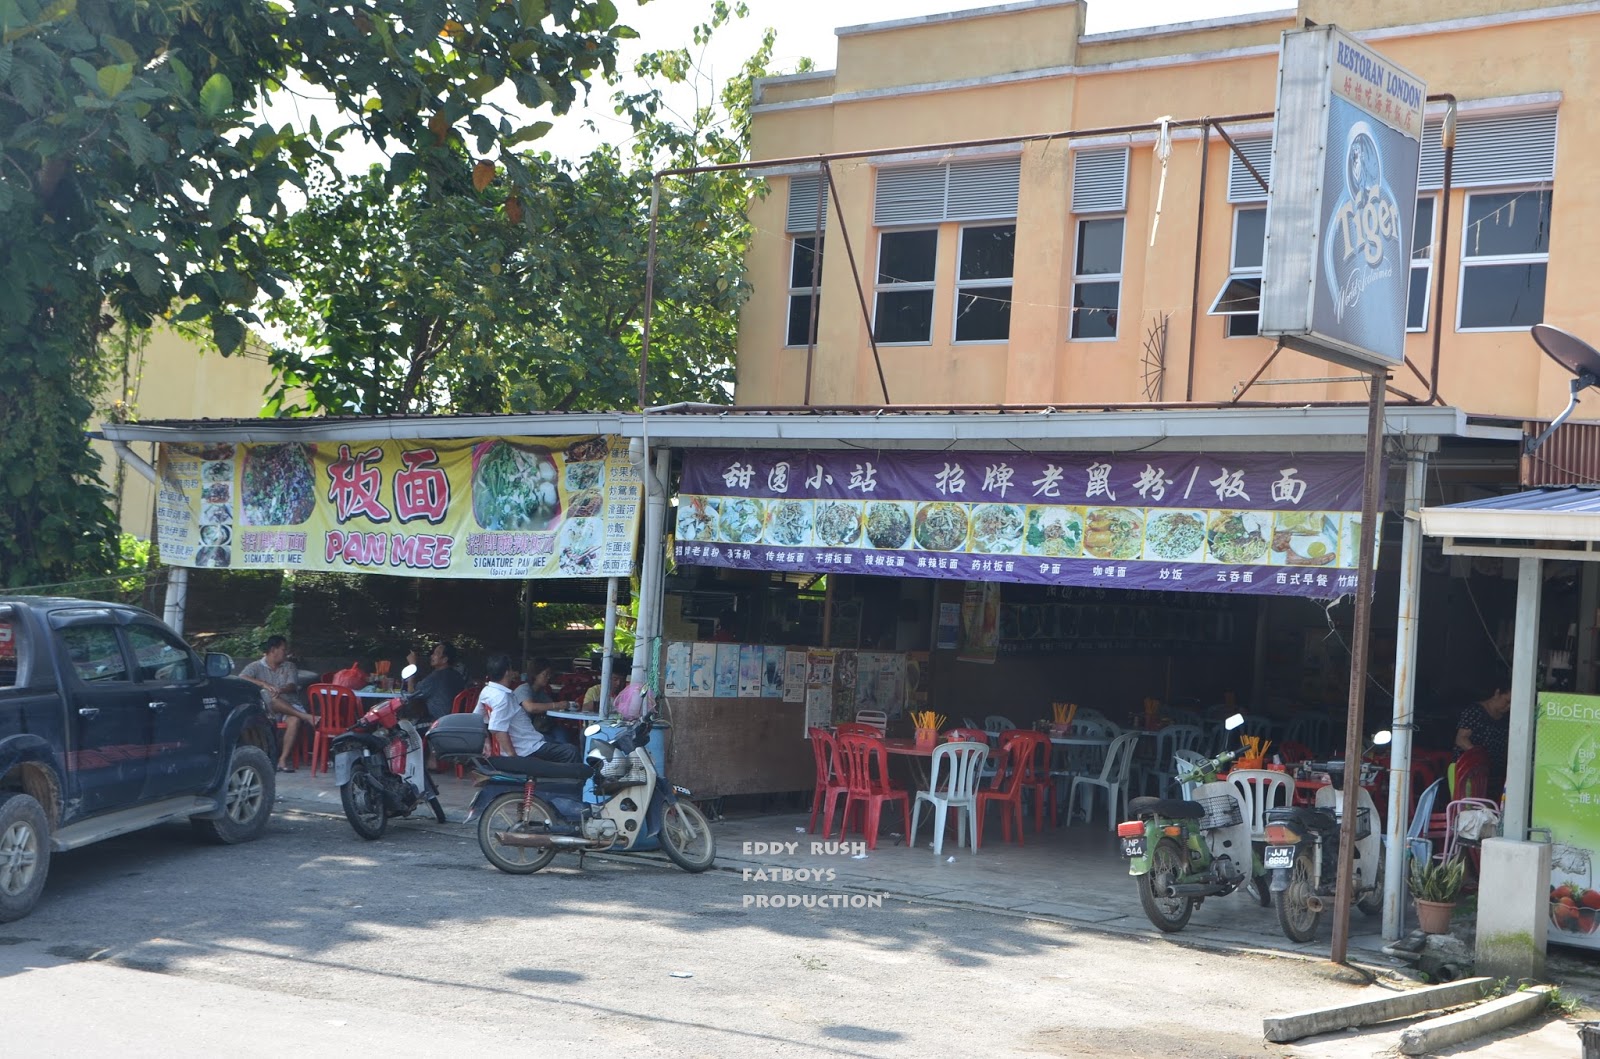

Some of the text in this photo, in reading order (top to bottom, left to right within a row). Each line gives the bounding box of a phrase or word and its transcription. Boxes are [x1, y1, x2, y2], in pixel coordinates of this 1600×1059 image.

[1337, 40, 1422, 109] RESTORAN LONDON
[1335, 185, 1400, 265] Tiger
[328, 444, 450, 526] 板面
[244, 553, 275, 563] SIGNATURE
[287, 554, 303, 563] MEE
[324, 530, 455, 569] PAN MEE
[473, 556, 547, 568] SIGNATURE PAN MEE
[765, 551, 804, 563] 传统板面
[864, 554, 905, 567] 辣椒板面
[917, 557, 958, 570] 麻辣板面
[971, 560, 1015, 572] 药材板面
[1039, 563, 1062, 575] 伊面
[1159, 568, 1183, 581] 炒饭
[1216, 570, 1253, 584] 云吞面
[1276, 572, 1328, 588] 西式早餐
[1125, 846, 1143, 856] 944
[1128, 839, 1139, 847] NP
